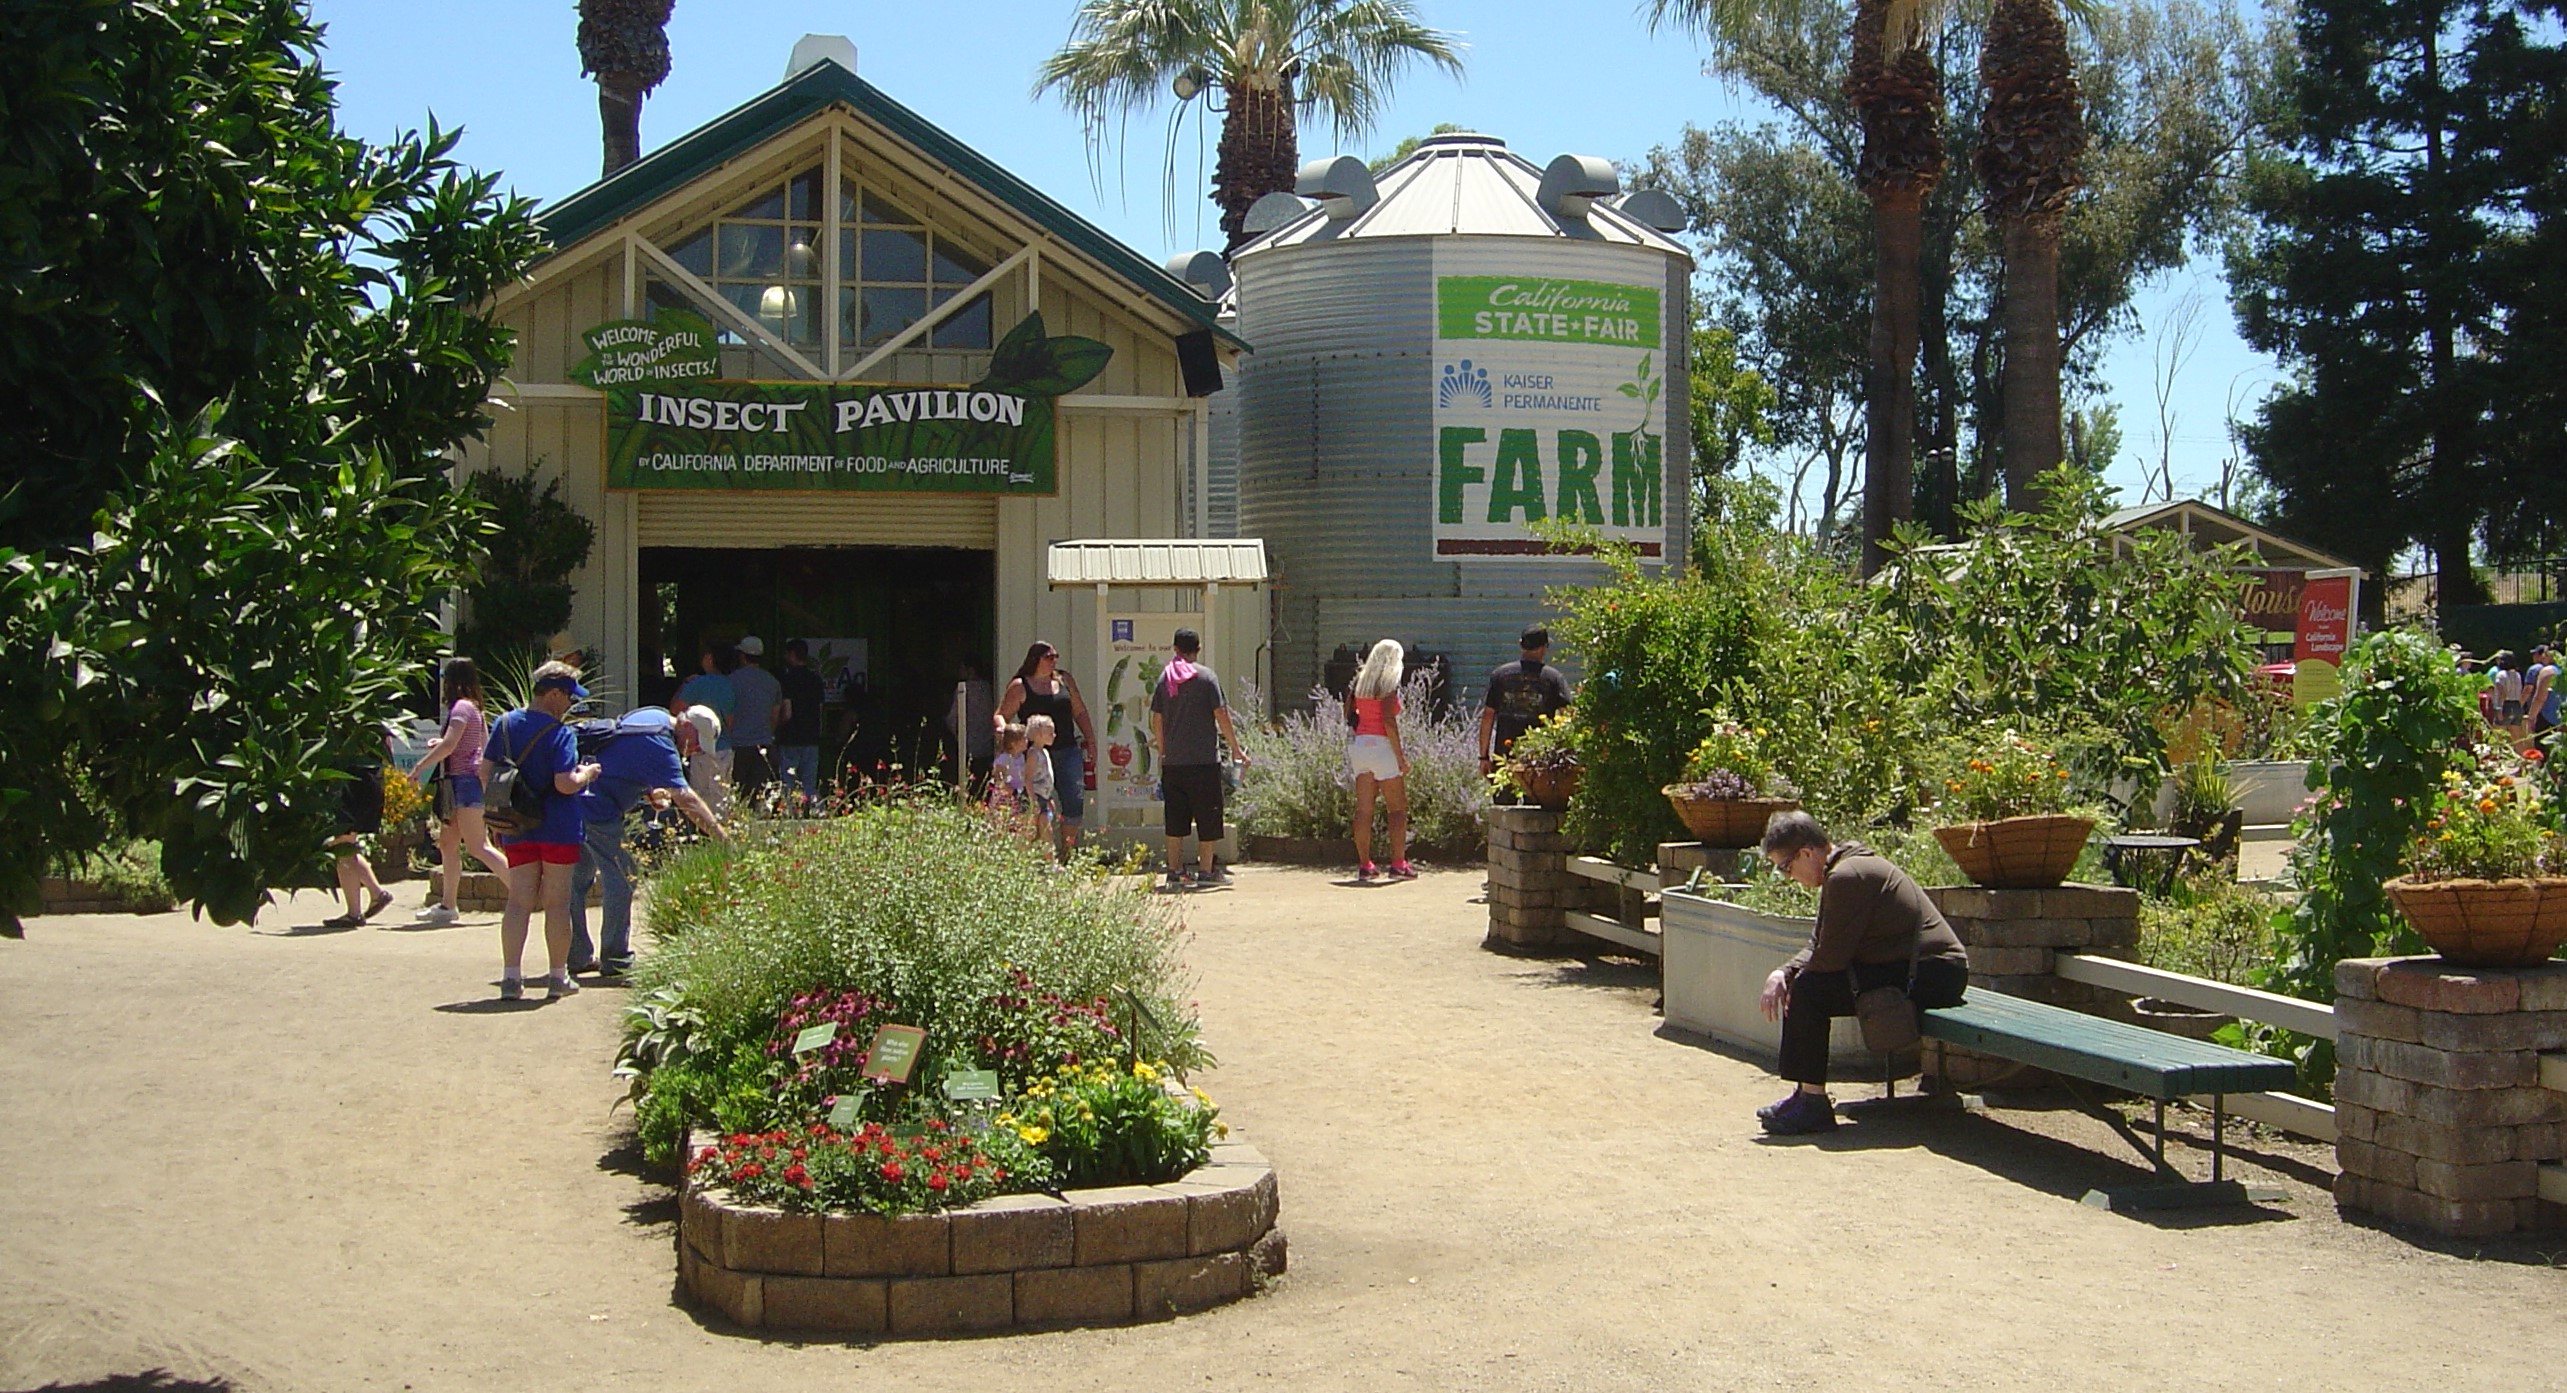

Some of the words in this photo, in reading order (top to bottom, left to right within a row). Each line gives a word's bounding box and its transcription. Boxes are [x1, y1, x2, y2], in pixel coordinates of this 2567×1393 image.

[1489, 282, 1631, 313] California
[592, 327, 658, 350] WELCOME
[1475, 311, 1568, 336] STATE
[1584, 315, 1640, 342] FAIR
[617, 332, 701, 367] WONDERFUL
[593, 367, 645, 385] WORLD
[654, 357, 717, 379] INSECTS!
[1503, 374, 1554, 390] KAISER
[637, 392, 809, 433] INSECT
[834, 390, 1026, 434] PAVILION
[1504, 394, 1601, 412] PERMANENTE
[638, 457, 650, 468] BY
[651, 452, 738, 471] CALIFORNIA
[743, 454, 835, 473] DEPARTMENT
[834, 459, 845, 469] OF
[846, 455, 888, 474] FOOD
[906, 457, 1011, 475] AGRICULTURE
[1438, 426, 1662, 528] FARM
[2304, 600, 2347, 622] Welcome
